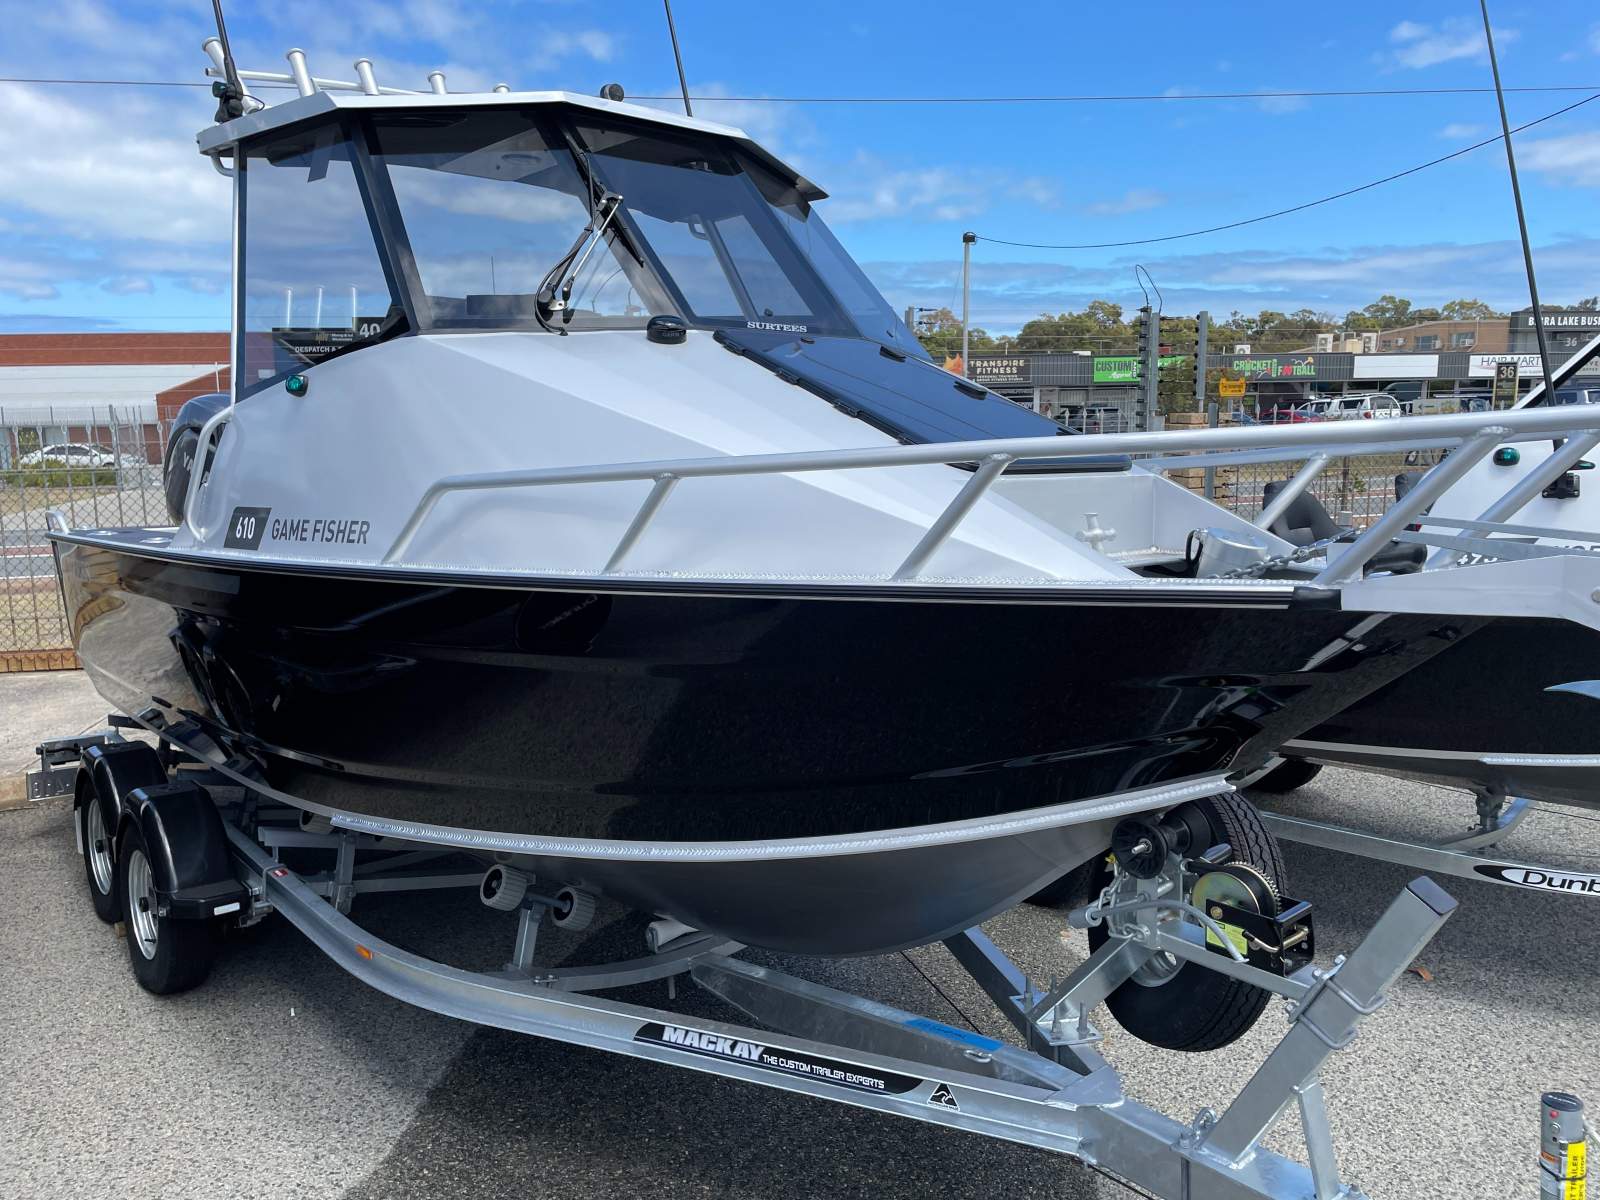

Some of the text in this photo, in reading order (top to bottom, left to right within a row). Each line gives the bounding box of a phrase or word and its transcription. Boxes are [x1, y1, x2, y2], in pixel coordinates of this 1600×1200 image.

[746, 321, 808, 333] SURTEES
[1528, 316, 1556, 326] BRA
[1557, 316, 1579, 326] LAKE
[1564, 337, 1578, 347] 36
[970, 359, 1025, 368] TRANSPIRE
[1095, 360, 1132, 372] CUSTOM
[977, 366, 1018, 374] FITNESS
[1500, 366, 1515, 378] 36
[235, 516, 371, 545] 610 GAME FISHER
[662, 1026, 766, 1061] MACKAY
[762, 1054, 885, 1089] THE CUSTOM TRAILER EXPERTS
